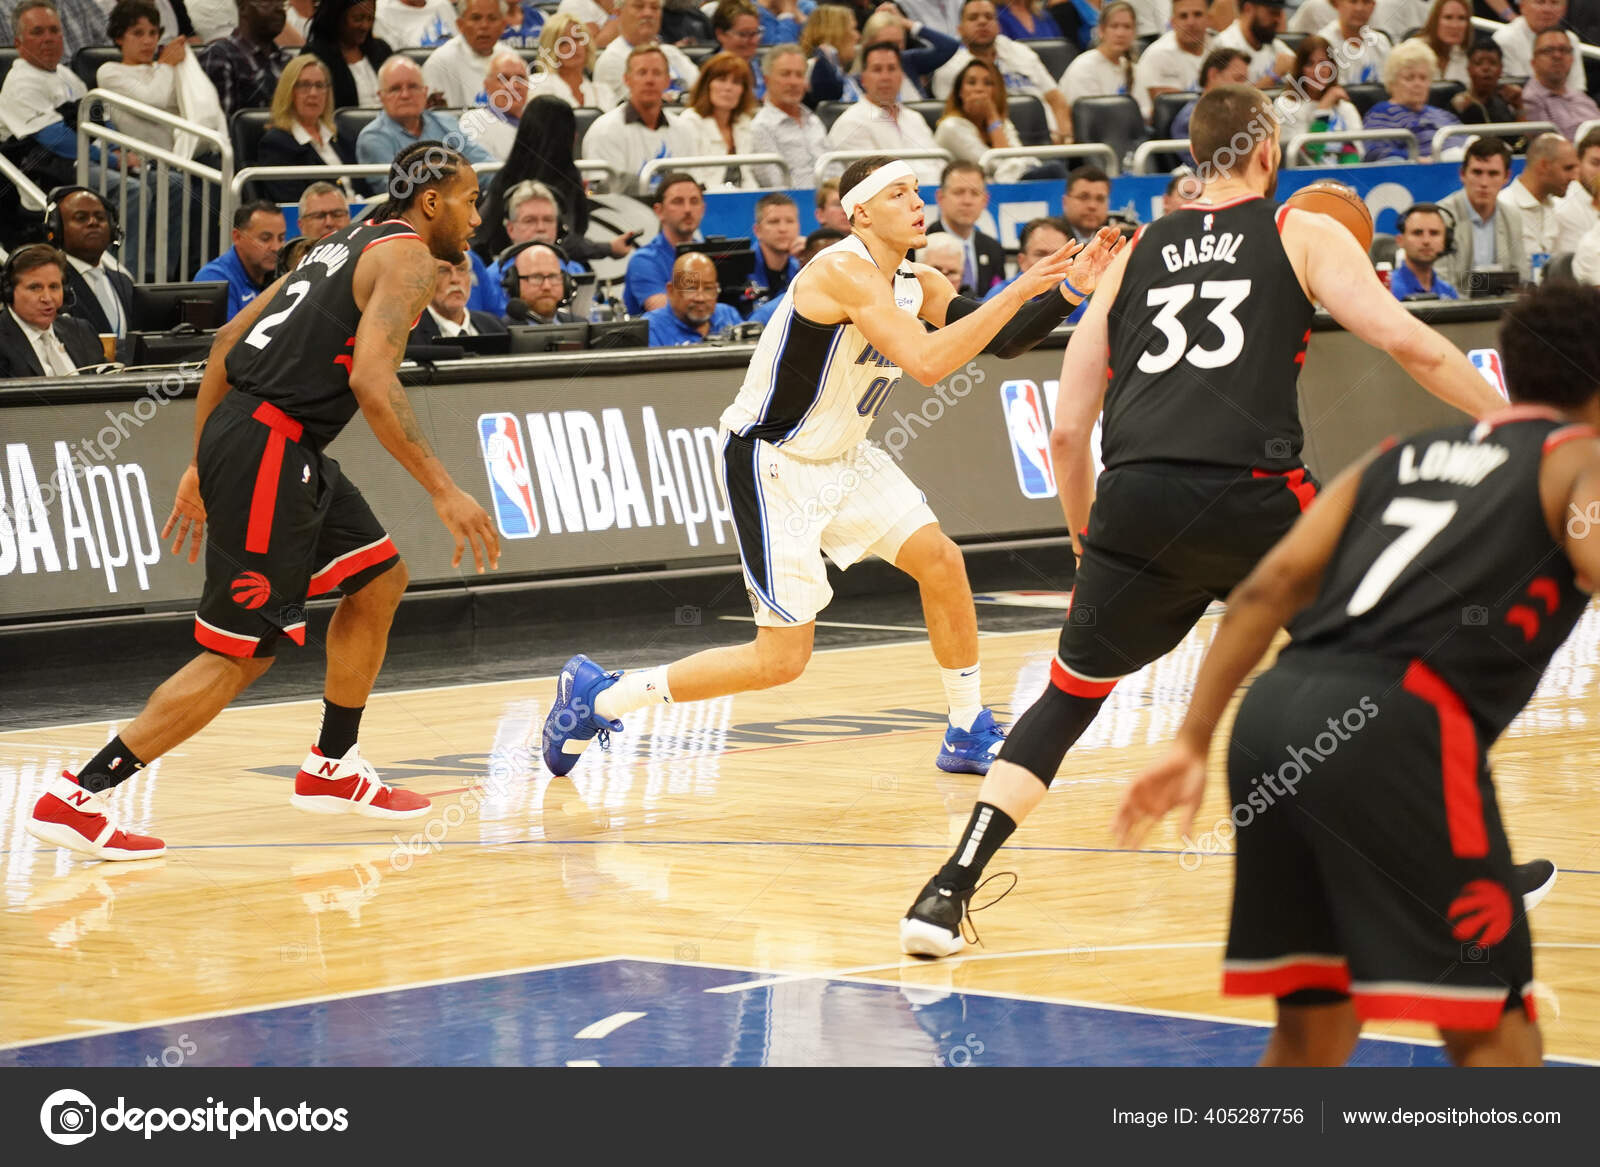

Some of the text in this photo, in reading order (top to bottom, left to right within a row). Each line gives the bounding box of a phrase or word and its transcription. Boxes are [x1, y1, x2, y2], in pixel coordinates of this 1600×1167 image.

[1161, 232, 1245, 273] GASOL
[244, 280, 311, 350] 2
[1136, 279, 1252, 374] 33
[54, 441, 161, 593] App
[525, 405, 733, 547] NBA App
[1346, 497, 1459, 617] 7
[318, 761, 340, 776] N
